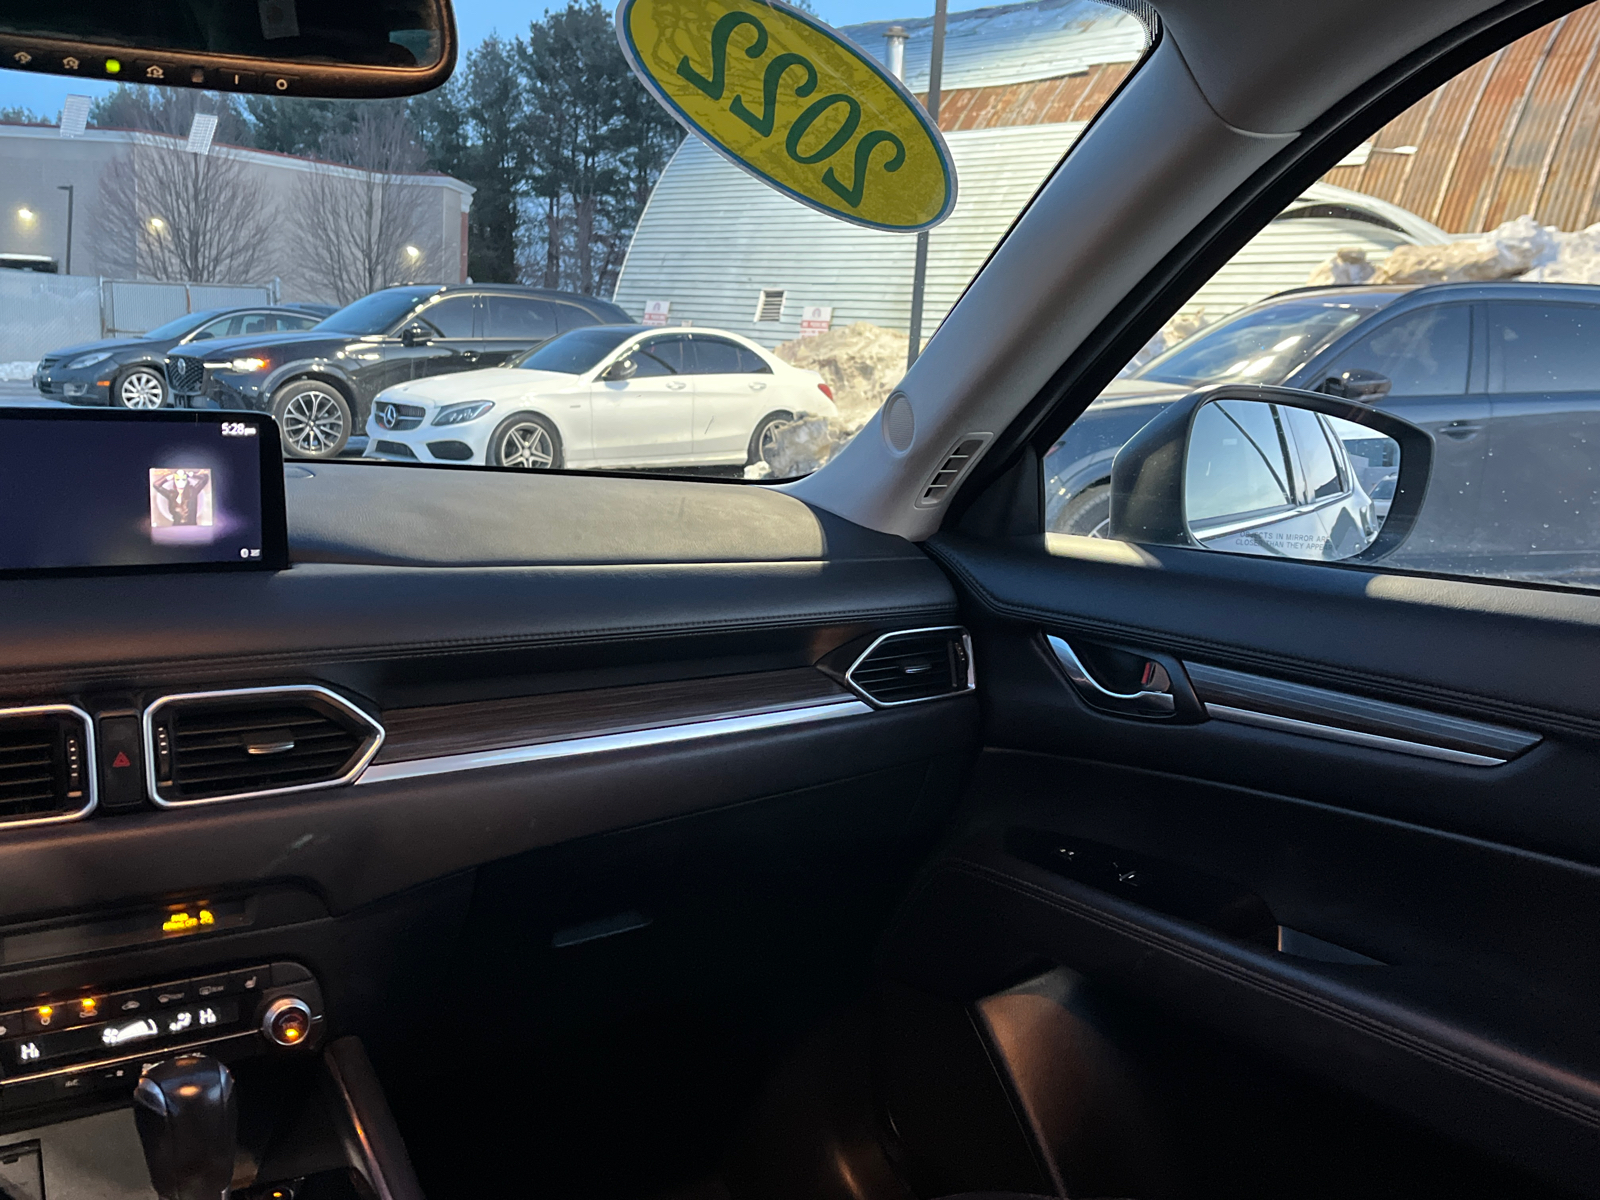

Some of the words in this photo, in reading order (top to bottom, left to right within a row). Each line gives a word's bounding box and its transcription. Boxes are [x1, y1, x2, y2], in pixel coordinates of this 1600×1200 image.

[1285, 533, 1314, 542] MIRROR
[1266, 540, 1284, 548] THAN
[1286, 541, 1304, 550] THEY
